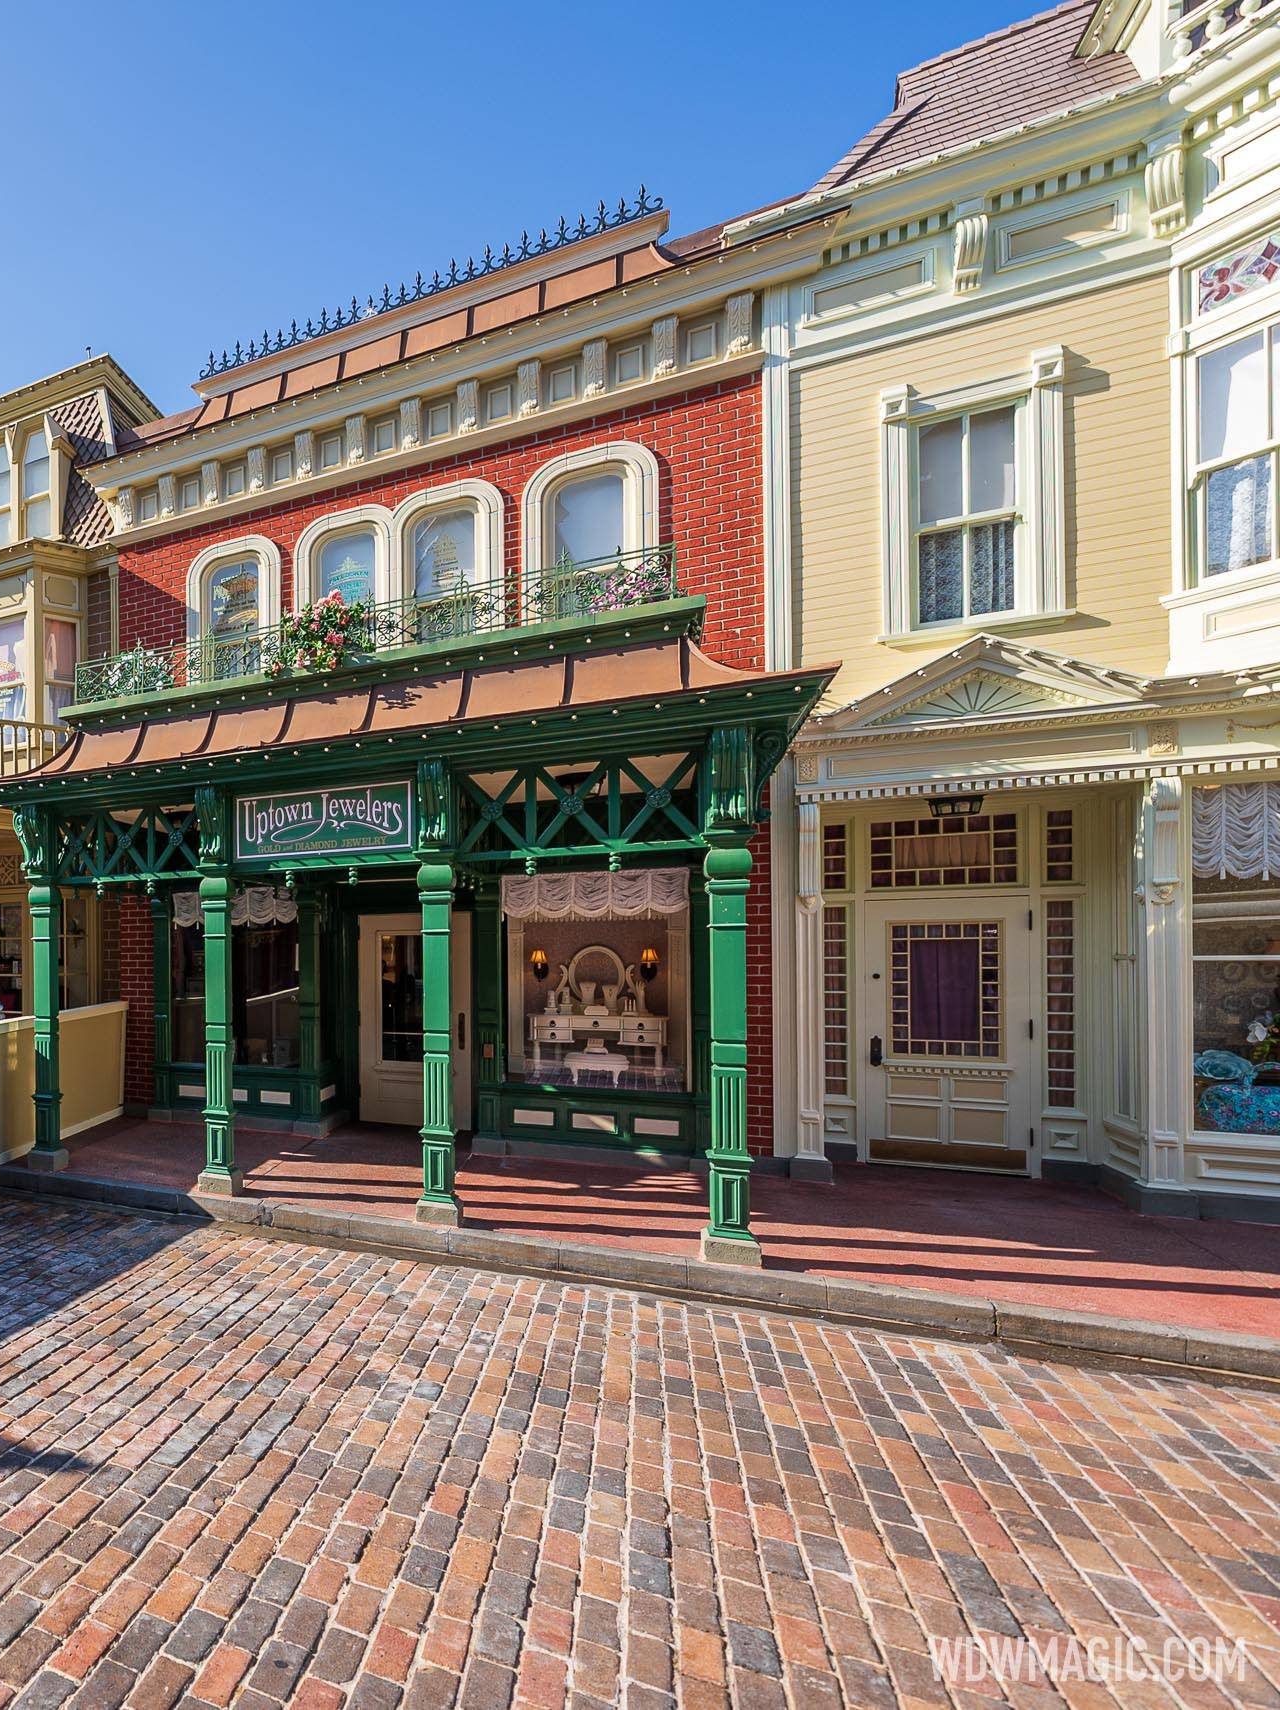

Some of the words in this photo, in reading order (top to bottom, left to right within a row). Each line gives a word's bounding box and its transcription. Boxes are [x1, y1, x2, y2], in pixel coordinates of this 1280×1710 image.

[243, 799, 313, 844] Uptown
[292, 789, 404, 840] Jewelers
[257, 843, 281, 854] GOLD
[295, 839, 338, 851] DIAMOND
[341, 835, 388, 848] JEWELRY
